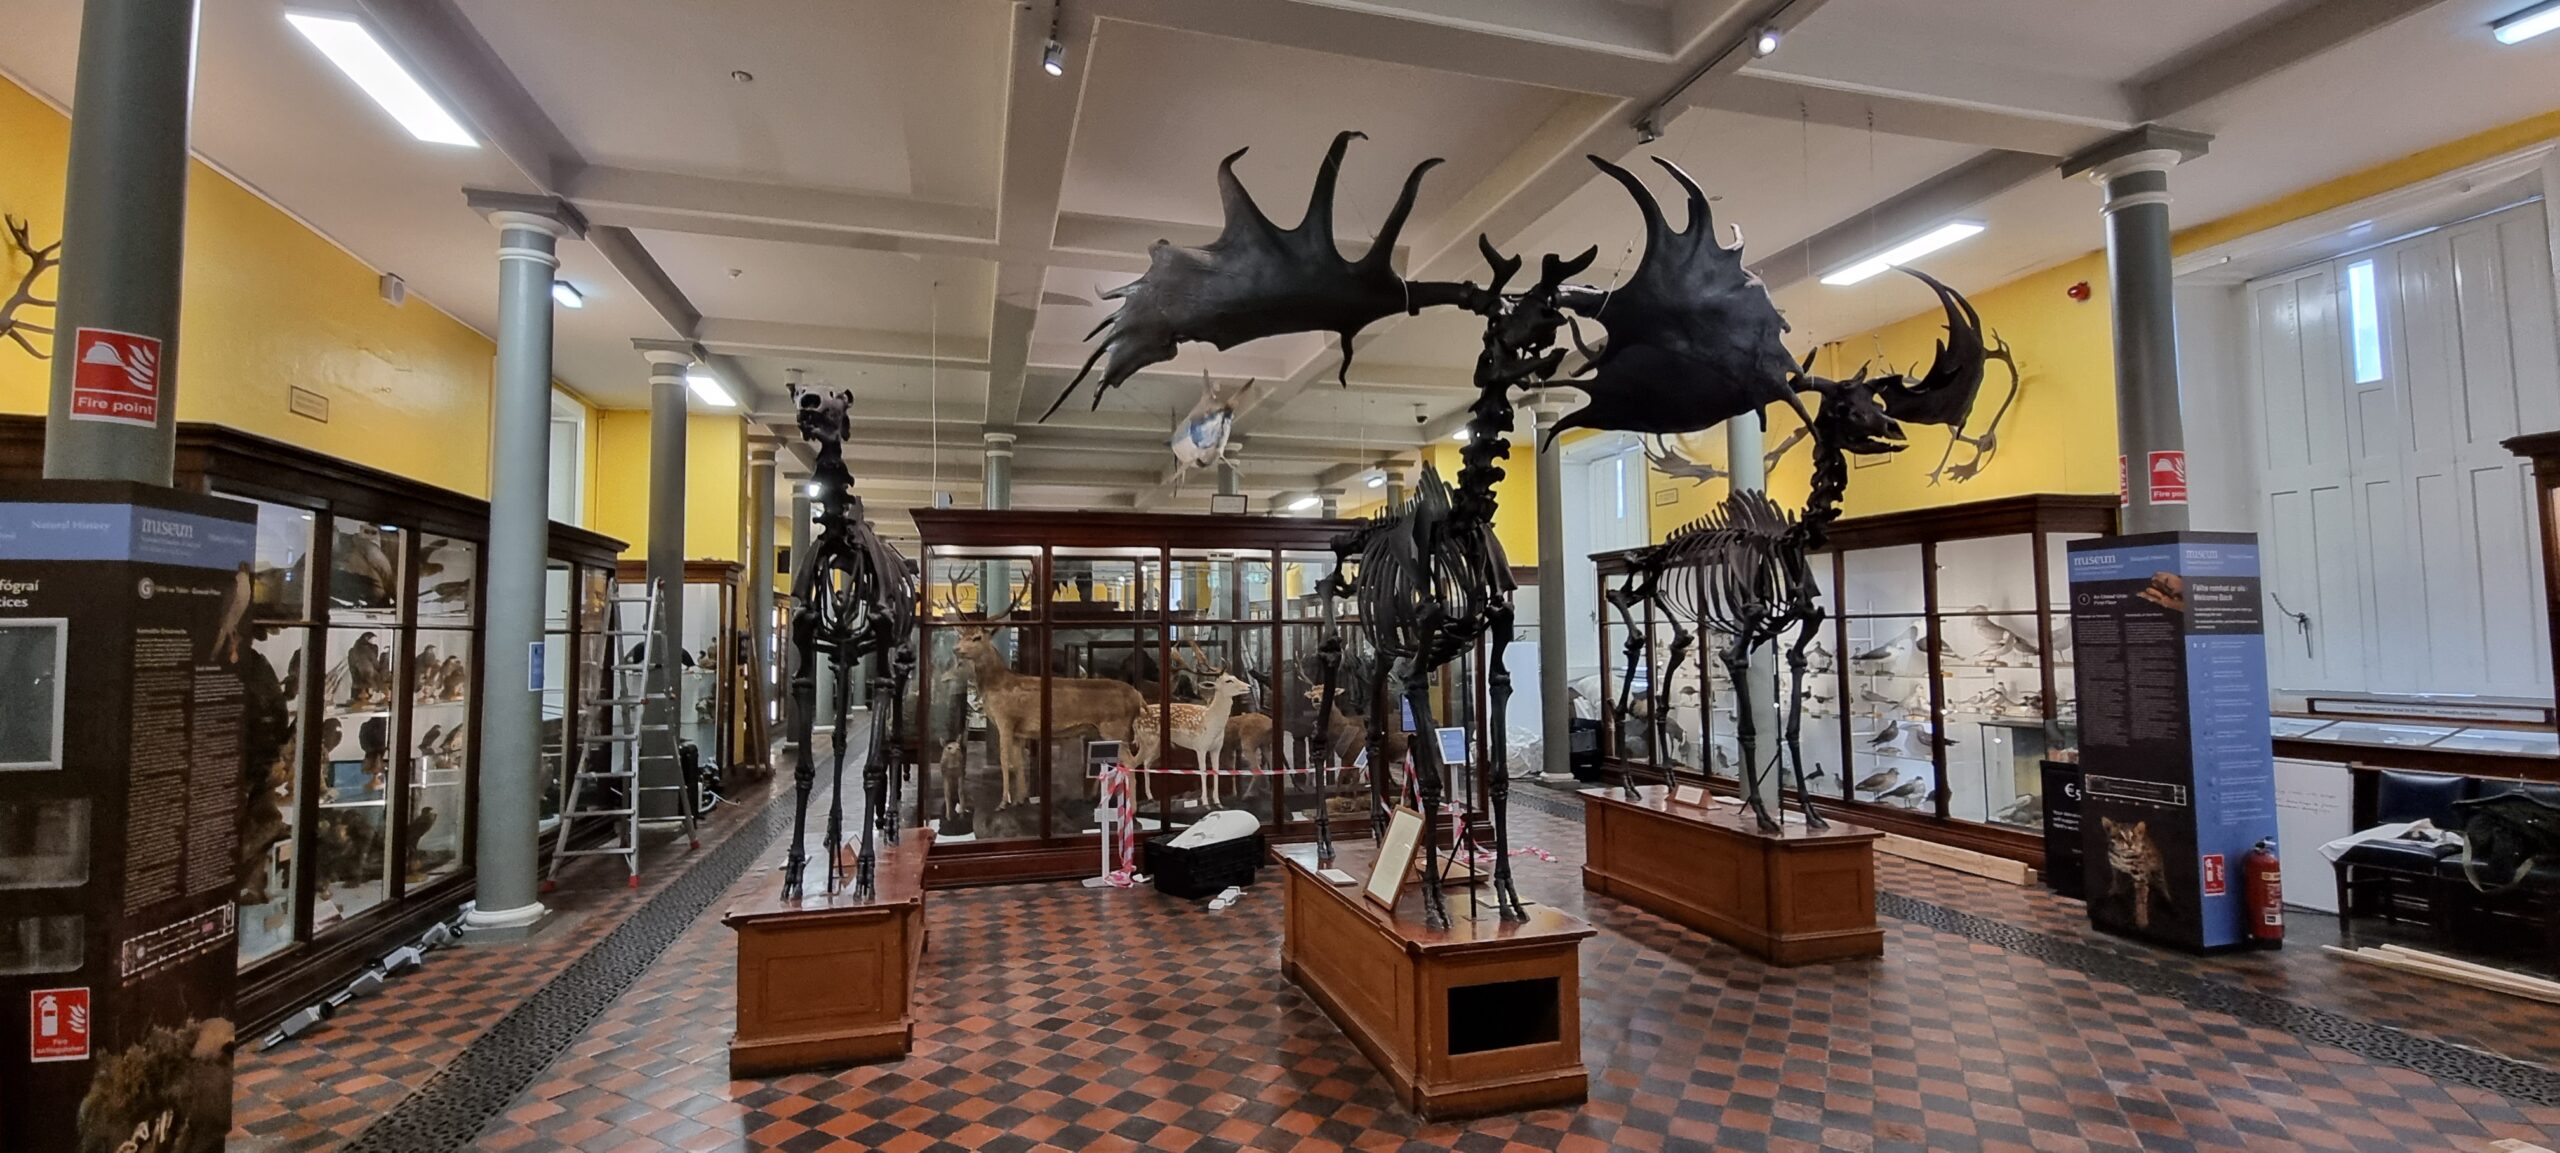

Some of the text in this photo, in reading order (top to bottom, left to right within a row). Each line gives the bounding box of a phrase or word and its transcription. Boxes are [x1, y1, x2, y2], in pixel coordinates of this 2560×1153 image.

[78, 397, 153, 415] Fire point
[142, 518, 194, 538] museum
[2074, 555, 2116, 566] museum
[142, 581, 152, 595] G
